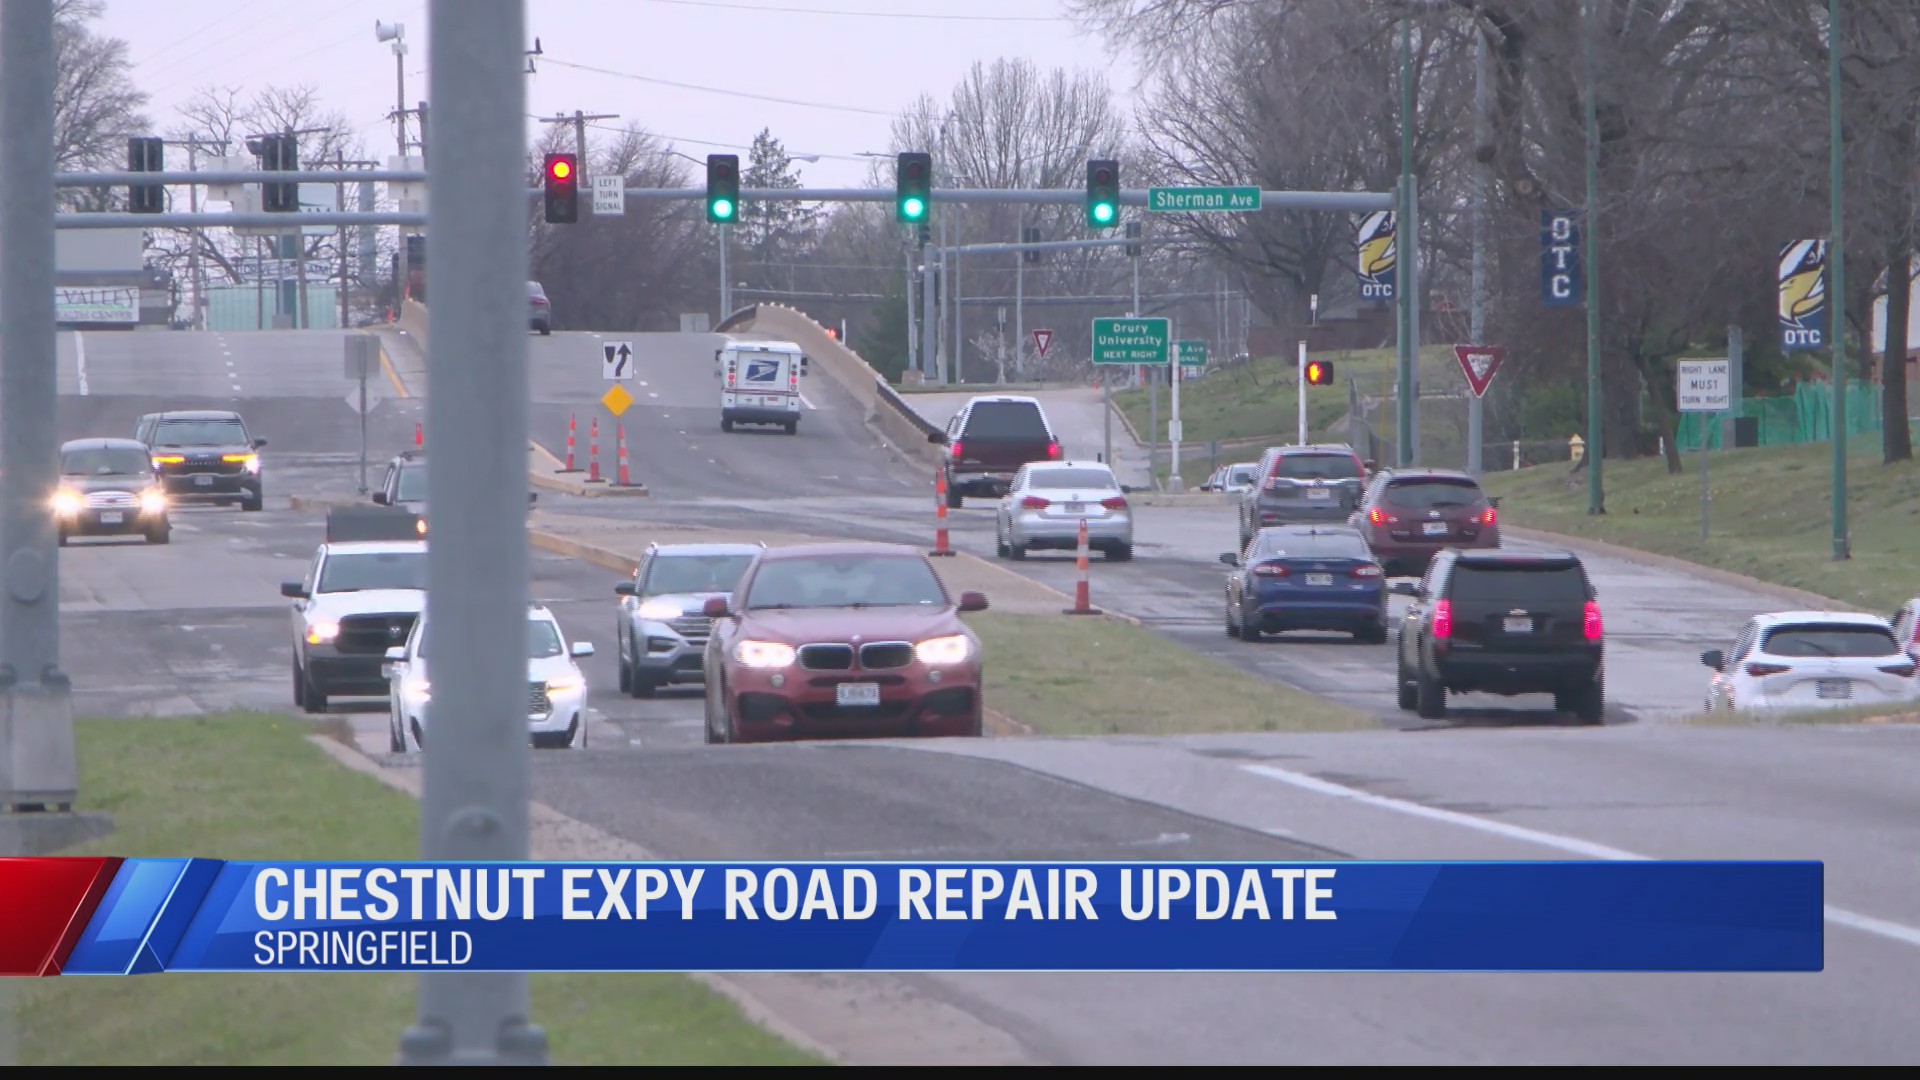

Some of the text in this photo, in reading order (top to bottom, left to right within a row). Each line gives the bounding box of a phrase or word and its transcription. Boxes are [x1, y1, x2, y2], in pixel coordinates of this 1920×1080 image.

[599, 179, 617, 187] LEFT
[599, 190, 618, 199] TURN
[1157, 191, 1253, 207] Sherman Ave
[595, 202, 621, 210] SIGNAL
[1552, 217, 1571, 298] OTC
[1362, 284, 1393, 296] OTC
[1113, 323, 1149, 335] Drury
[1099, 335, 1162, 347] University
[1785, 329, 1821, 345] OTC
[1103, 350, 1158, 359] NEXT RIGHT
[1681, 365, 1728, 374] RIGHT LANE
[1690, 379, 1719, 390] MUST
[1681, 395, 1729, 404] TURN RIGHT
